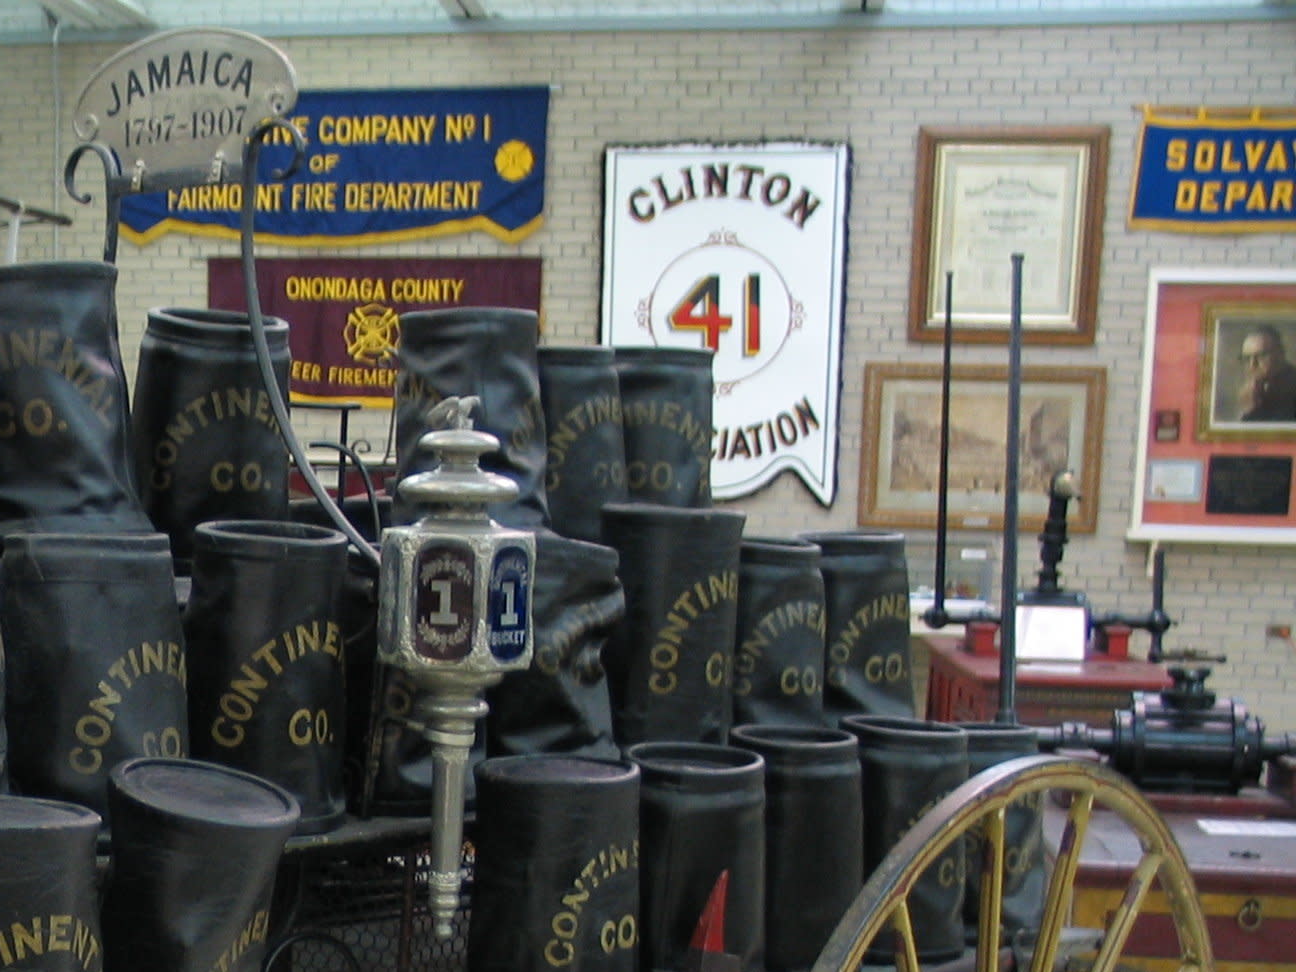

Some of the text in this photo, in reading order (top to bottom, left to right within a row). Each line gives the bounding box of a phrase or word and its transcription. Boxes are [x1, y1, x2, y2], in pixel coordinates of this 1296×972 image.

[106, 50, 253, 118] JAMAICA
[124, 105, 247, 148] 1797-1907
[318, 115, 436, 145] COMPANY
[309, 154, 341, 173] OF
[1165, 138, 1296, 173] SOLVA
[168, 181, 483, 212] FAIRMONT FIRE DEPARTMENT
[628, 162, 822, 231] CLINTON
[286, 276, 465, 302] ONONDAGA COUNTY
[668, 272, 761, 359] 41
[211, 461, 272, 492] CO.
[429, 579, 459, 626] 1
[500, 580, 519, 627] 1
[211, 620, 344, 748] CONTINE
[288, 707, 334, 747] CO.
